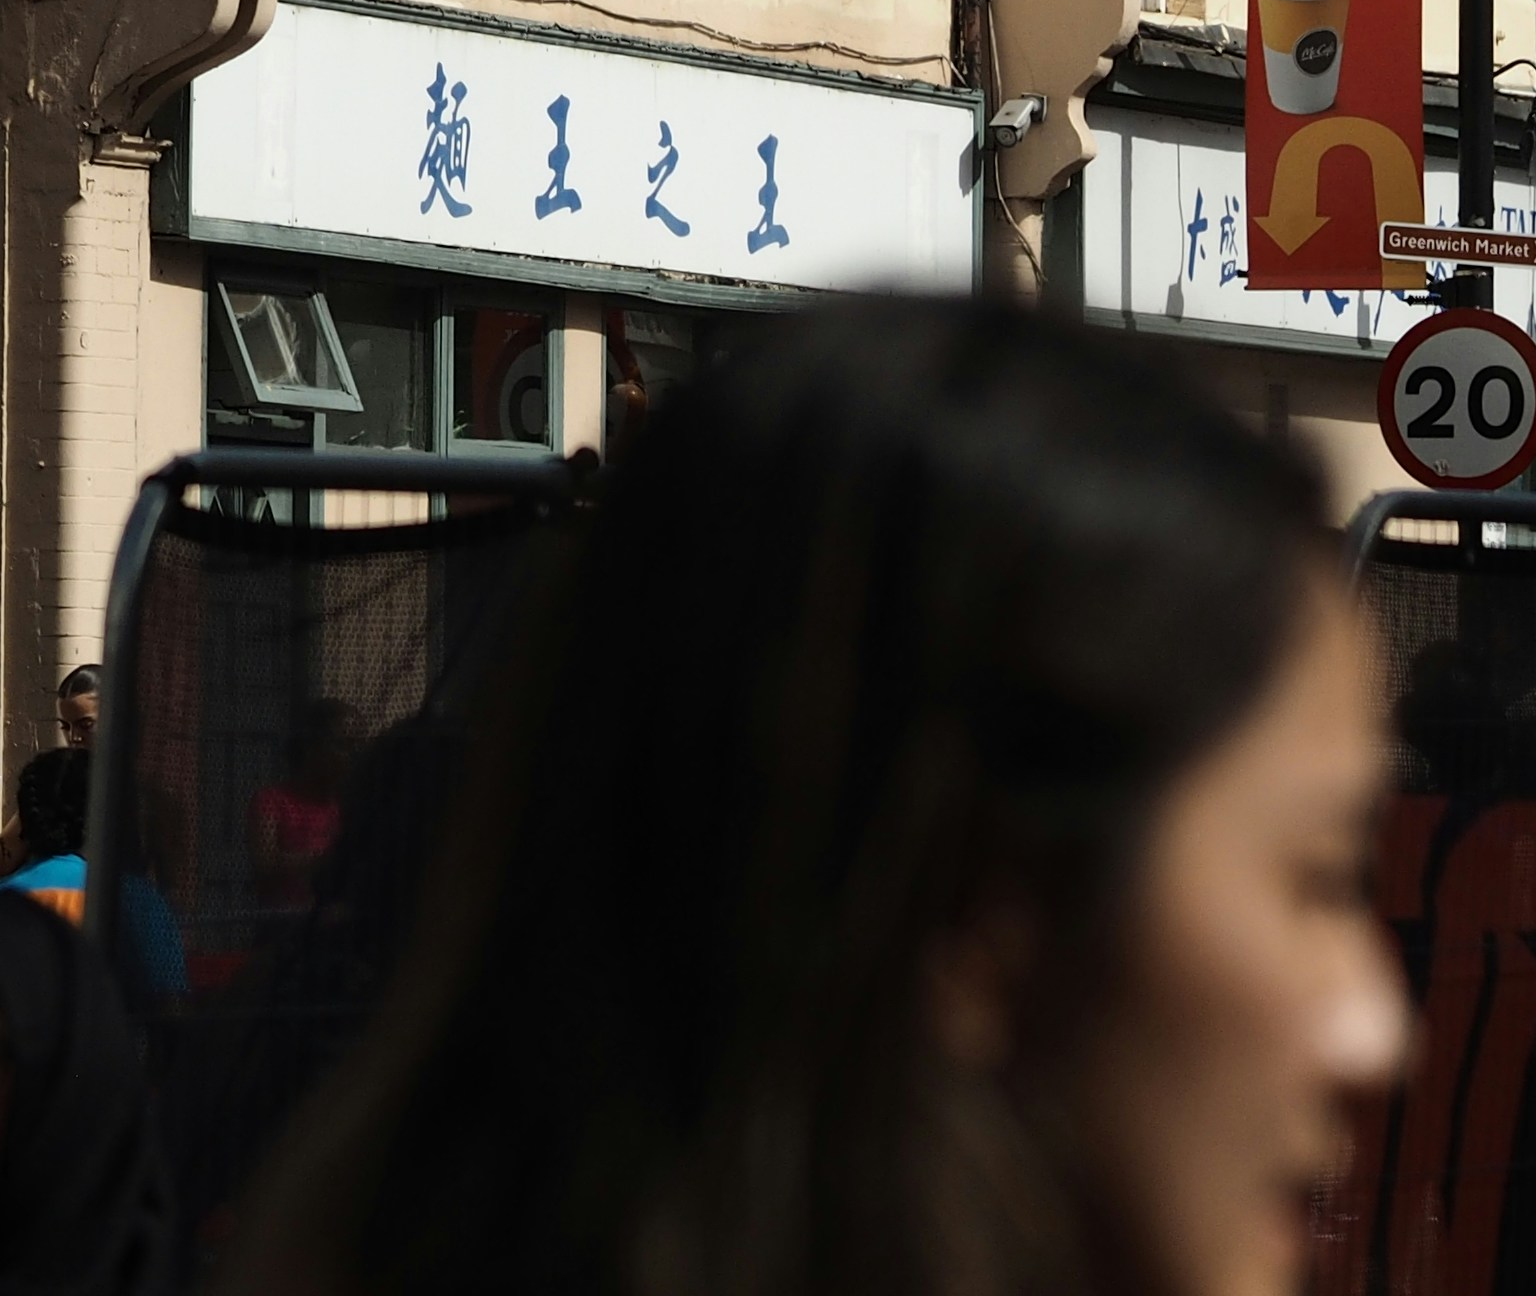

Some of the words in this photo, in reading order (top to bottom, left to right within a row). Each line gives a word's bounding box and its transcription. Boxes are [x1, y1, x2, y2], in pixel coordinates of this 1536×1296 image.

[1388, 232, 1469, 255] Greenwich
[1475, 240, 1531, 259] Market
[1404, 364, 1526, 440] 20
